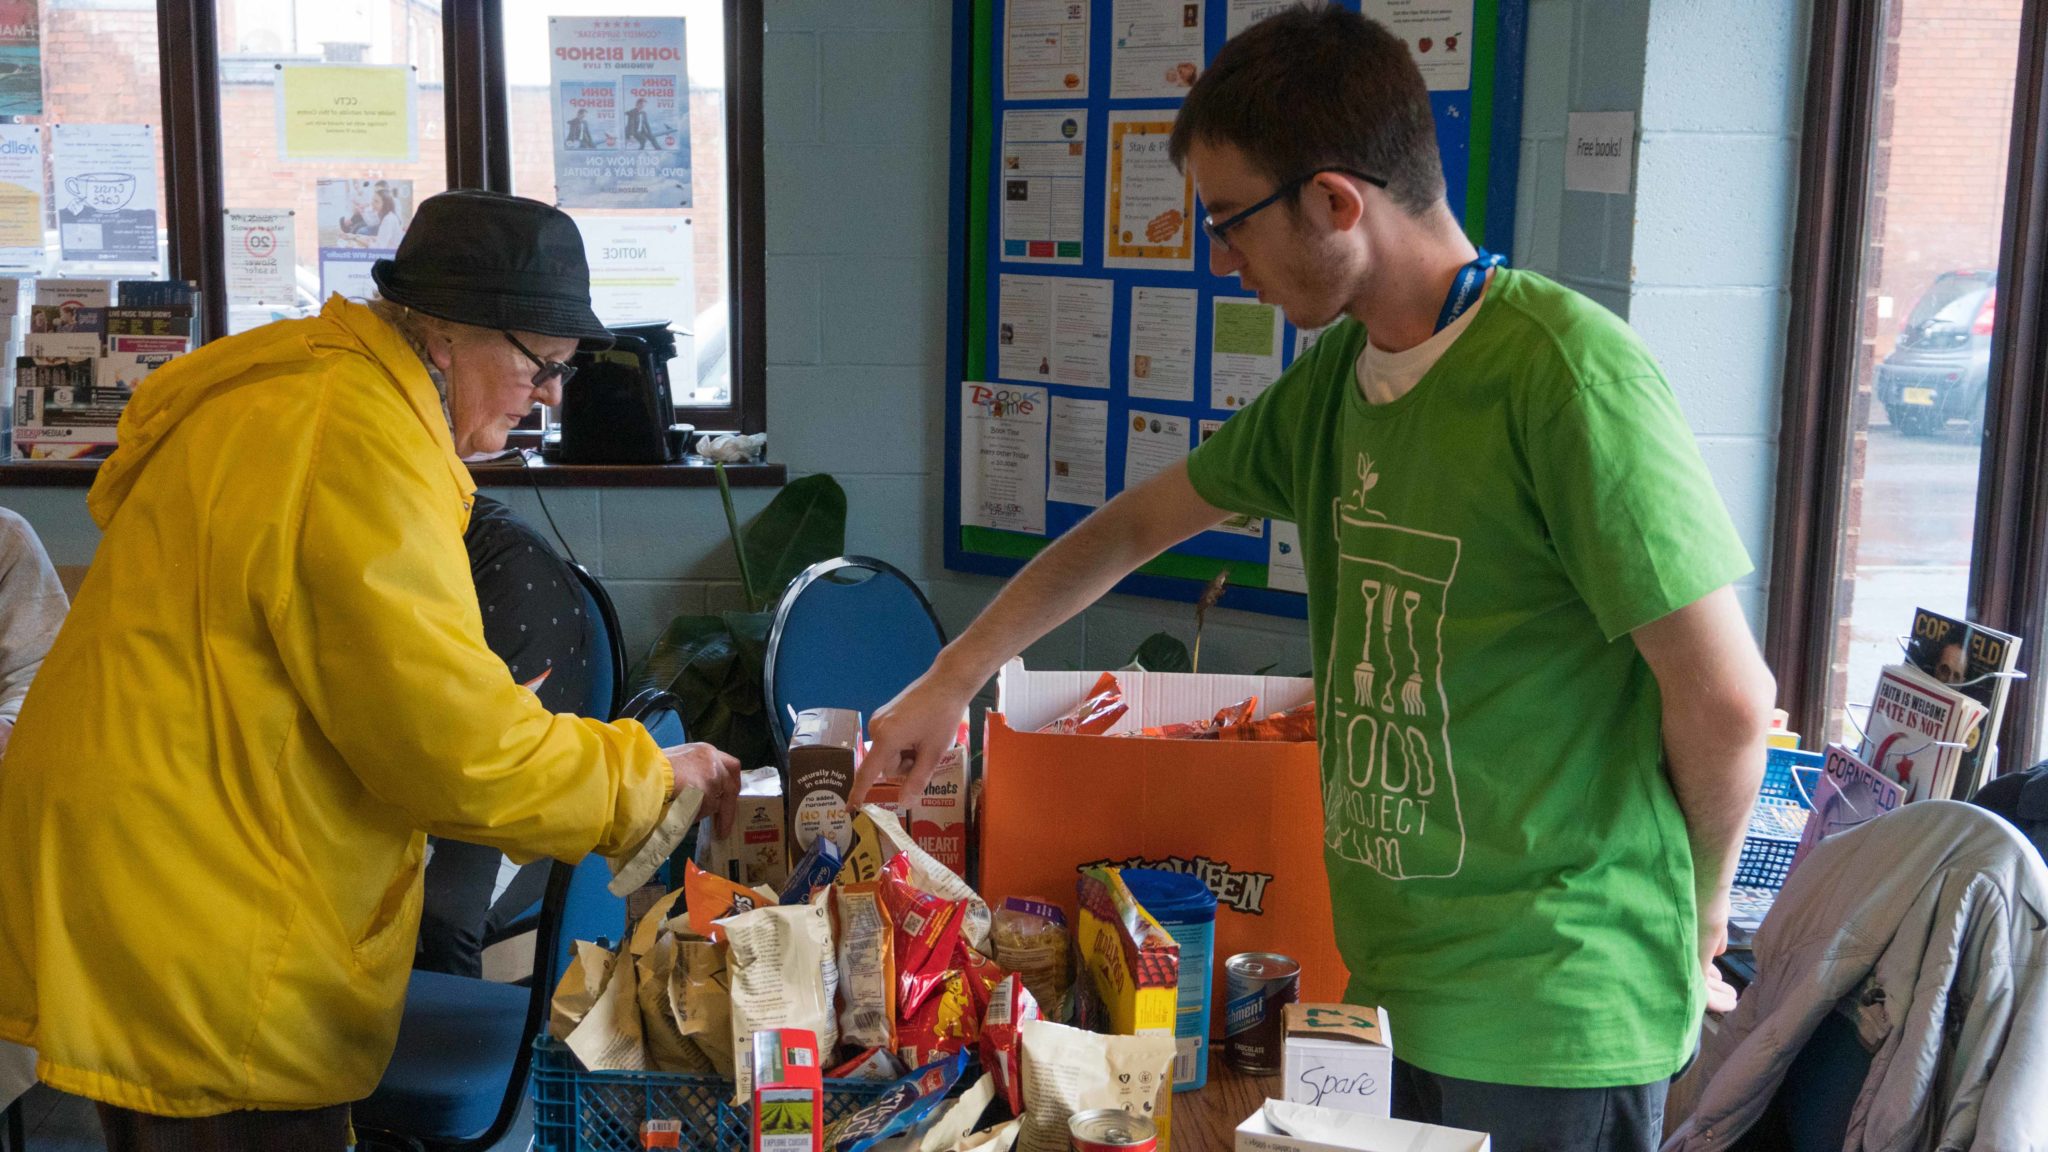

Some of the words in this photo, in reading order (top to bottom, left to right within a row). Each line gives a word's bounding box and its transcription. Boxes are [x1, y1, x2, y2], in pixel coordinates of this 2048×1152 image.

[1128, 142, 1147, 153] Stay
[1159, 141, 1169, 152] Pl
[1577, 137, 1594, 156] Free
[1595, 136, 1622, 157] books!
[1914, 613, 2001, 667] CORELD
[1881, 681, 1902, 700] FAITH
[1901, 693, 1911, 706] IS
[1911, 695, 1948, 723] WELCOME
[1908, 714, 1918, 730] IS
[1919, 716, 1943, 740] NOT
[797, 769, 829, 784] naturally
[831, 769, 847, 780] high
[814, 777, 843, 788] calcium
[1827, 752, 1896, 811] CORNFIELD
[800, 810, 820, 821] NO
[827, 809, 846, 820] NO
[918, 836, 959, 852] HEART
[1234, 1043, 1264, 1054] CHOCOLATE
[1300, 1066, 1377, 1107] Spare
